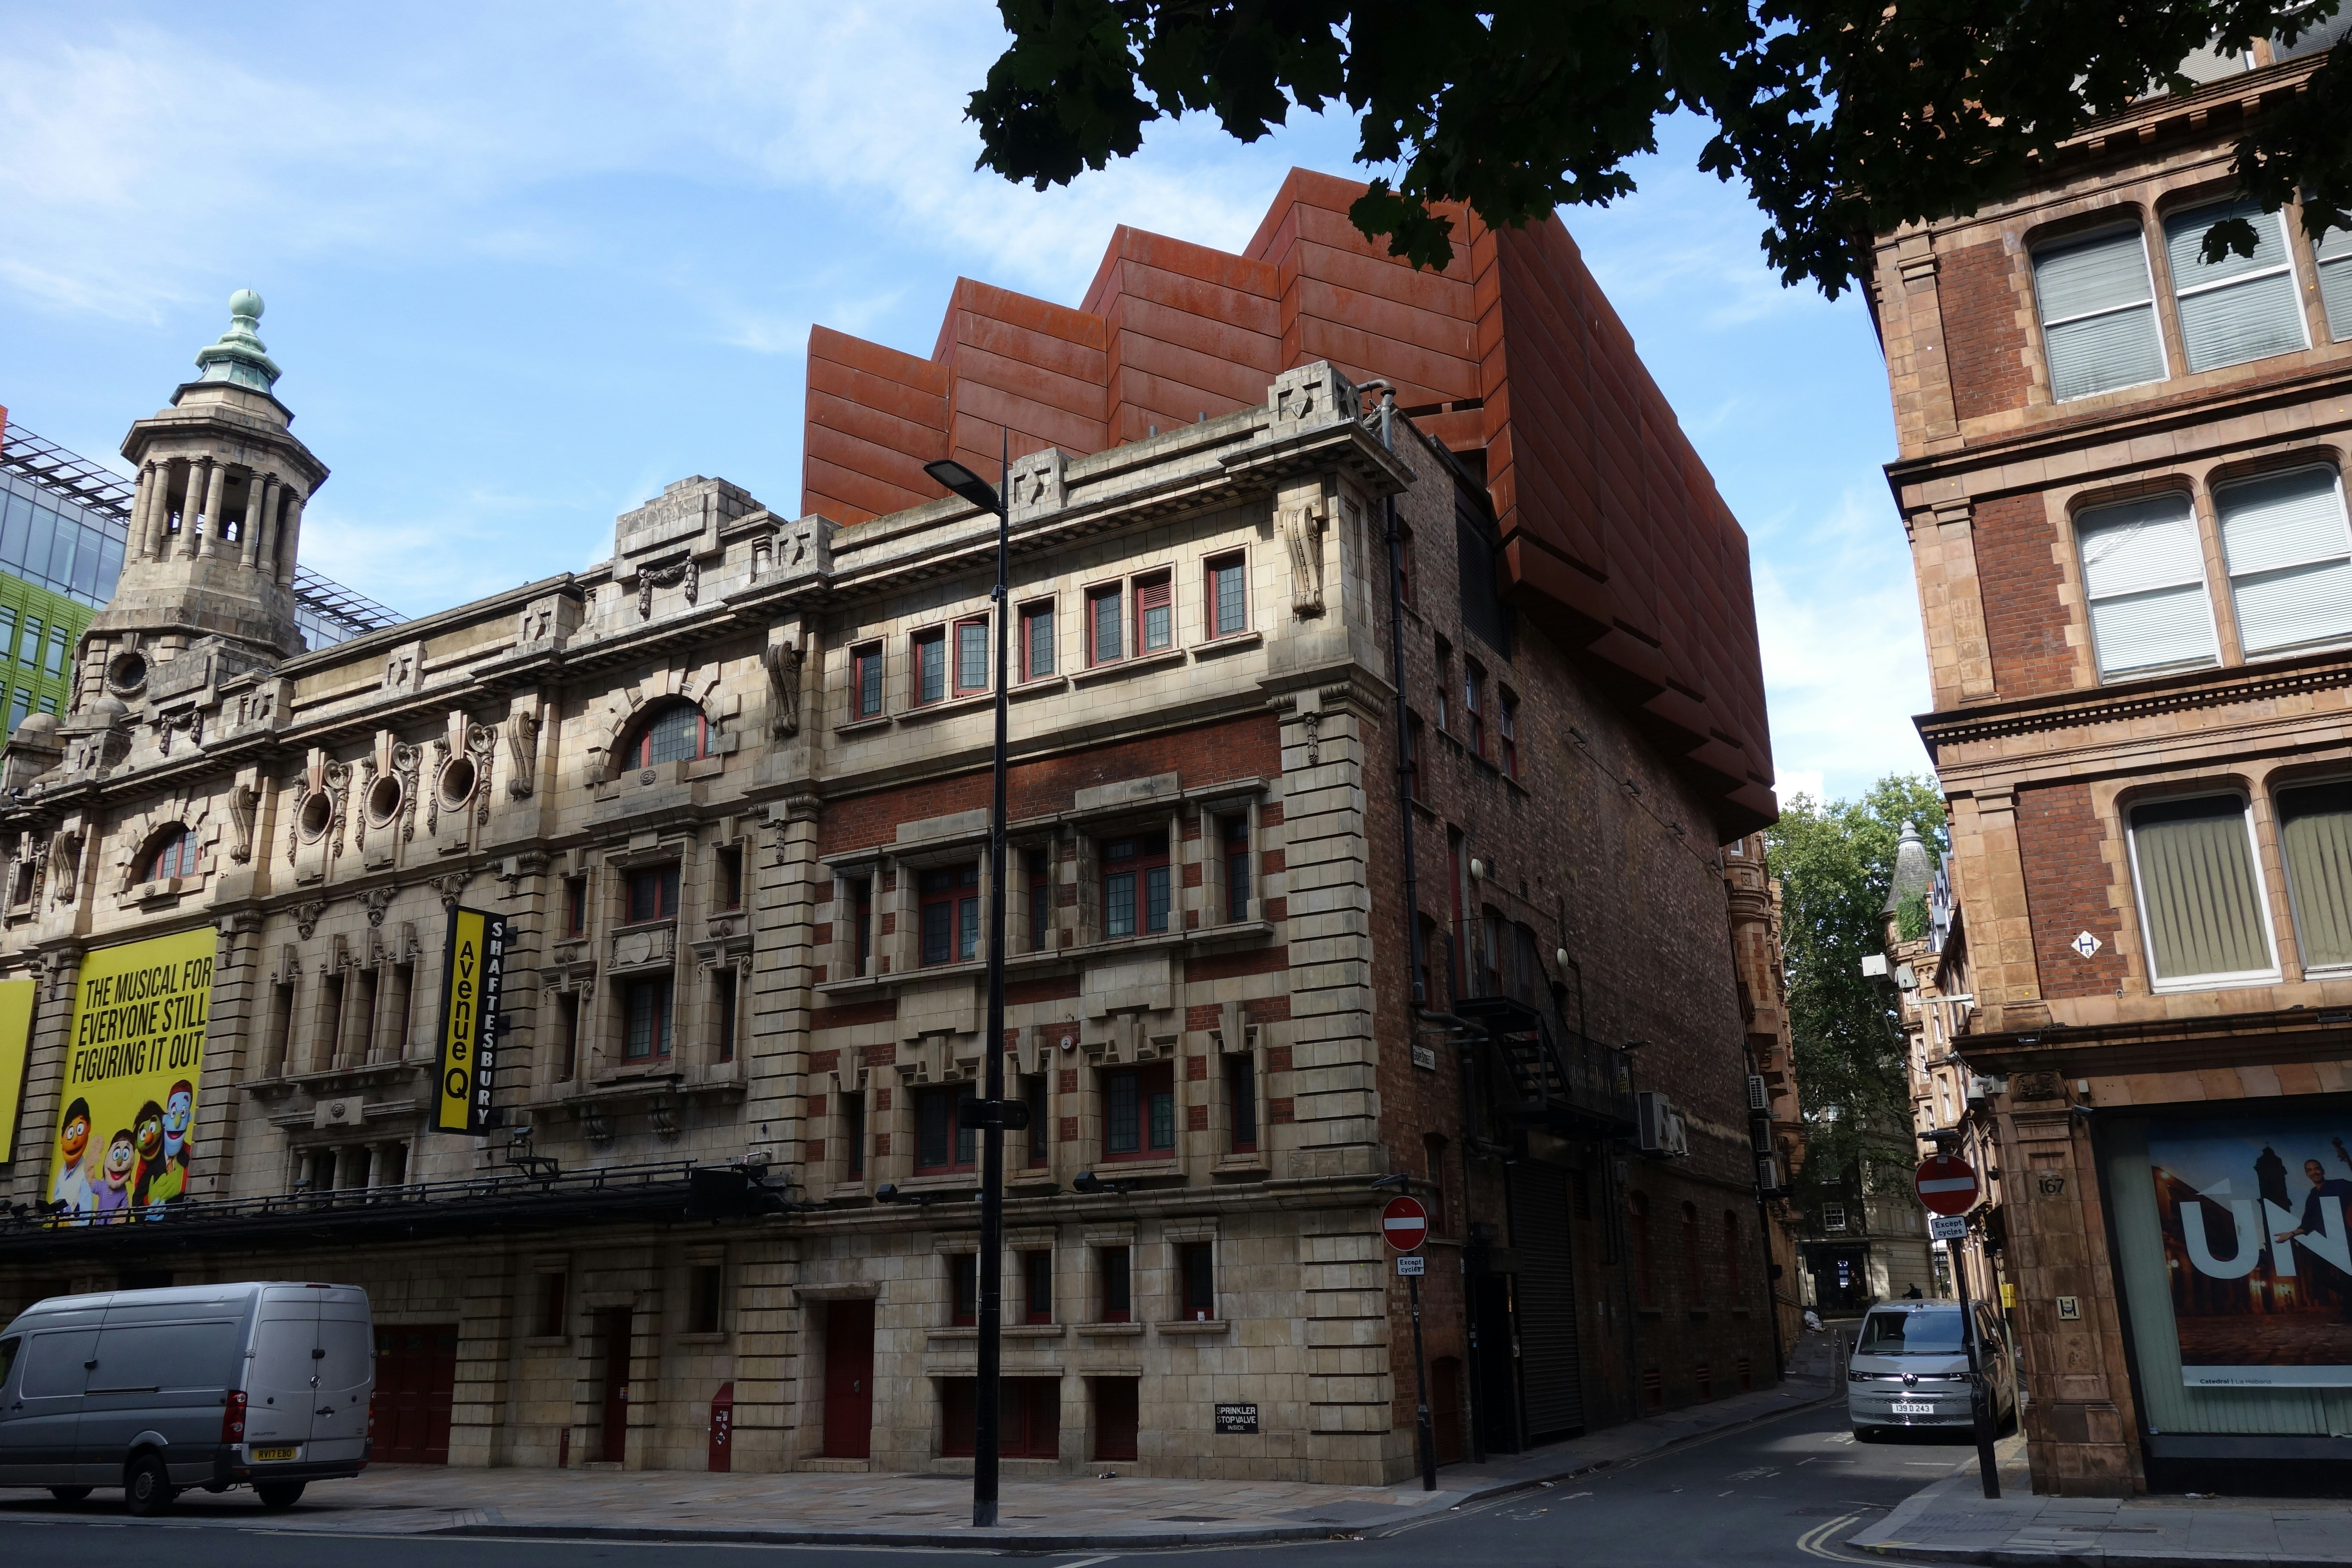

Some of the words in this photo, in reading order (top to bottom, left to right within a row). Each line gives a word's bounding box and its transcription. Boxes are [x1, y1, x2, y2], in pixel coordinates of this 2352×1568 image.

[2079, 937, 2095, 952] H
[86, 976, 113, 1010] THE
[114, 963, 178, 1004] MUSICAL
[182, 956, 213, 992] FOR
[452, 940, 474, 1061] Avenue
[78, 1001, 159, 1047] EVERYONE
[162, 992, 206, 1032] STILL
[476, 922, 503, 1125] SHAFTESBURY
[72, 1040, 146, 1084] FIGURING
[148, 1036, 167, 1072] IT
[168, 1030, 204, 1069] OUT
[445, 1067, 468, 1100] Q
[2039, 1178, 2064, 1194] 167
[1936, 1220, 1962, 1228] Except
[258, 1450, 276, 1458] RV17
